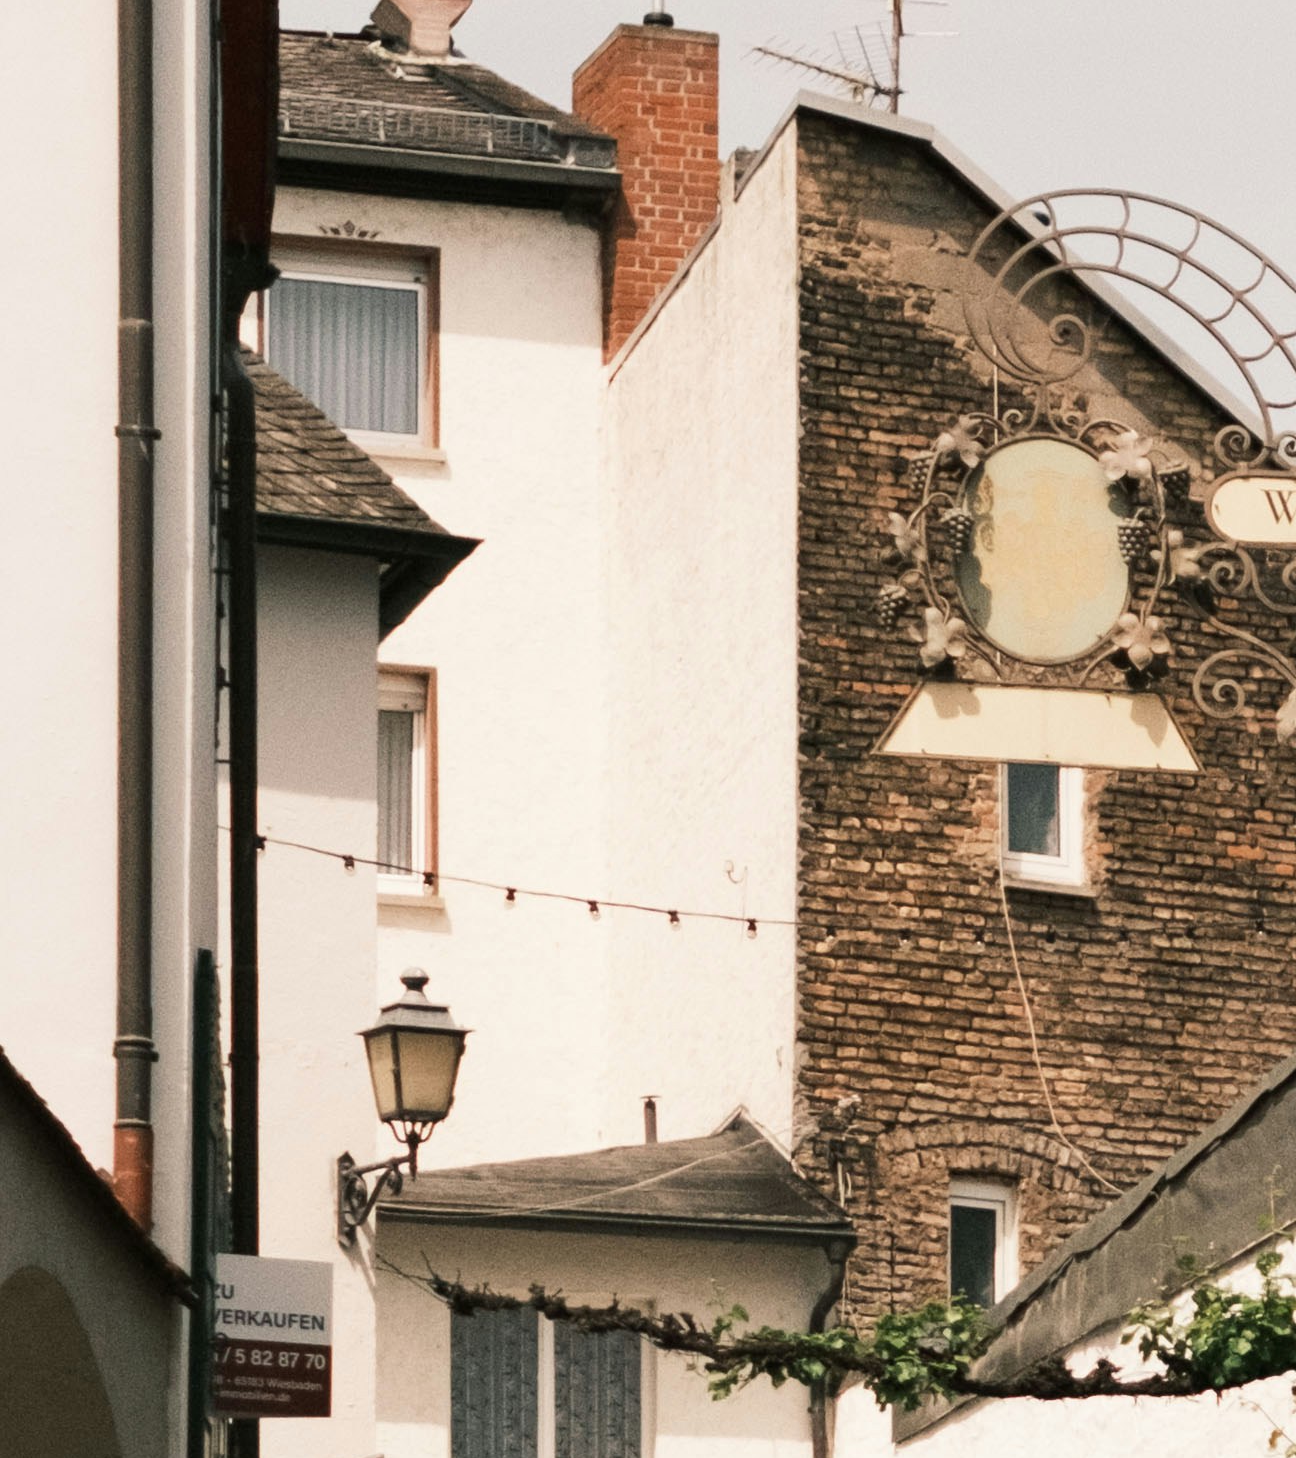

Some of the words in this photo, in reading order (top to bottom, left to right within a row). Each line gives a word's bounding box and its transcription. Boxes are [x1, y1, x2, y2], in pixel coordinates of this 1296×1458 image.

[235, 1348, 246, 1364] 5
[250, 1349, 273, 1366] 82
[278, 1351, 300, 1368] 87
[304, 1353, 326, 1370] 70
[267, 1378, 322, 1391] Wiesbaden
